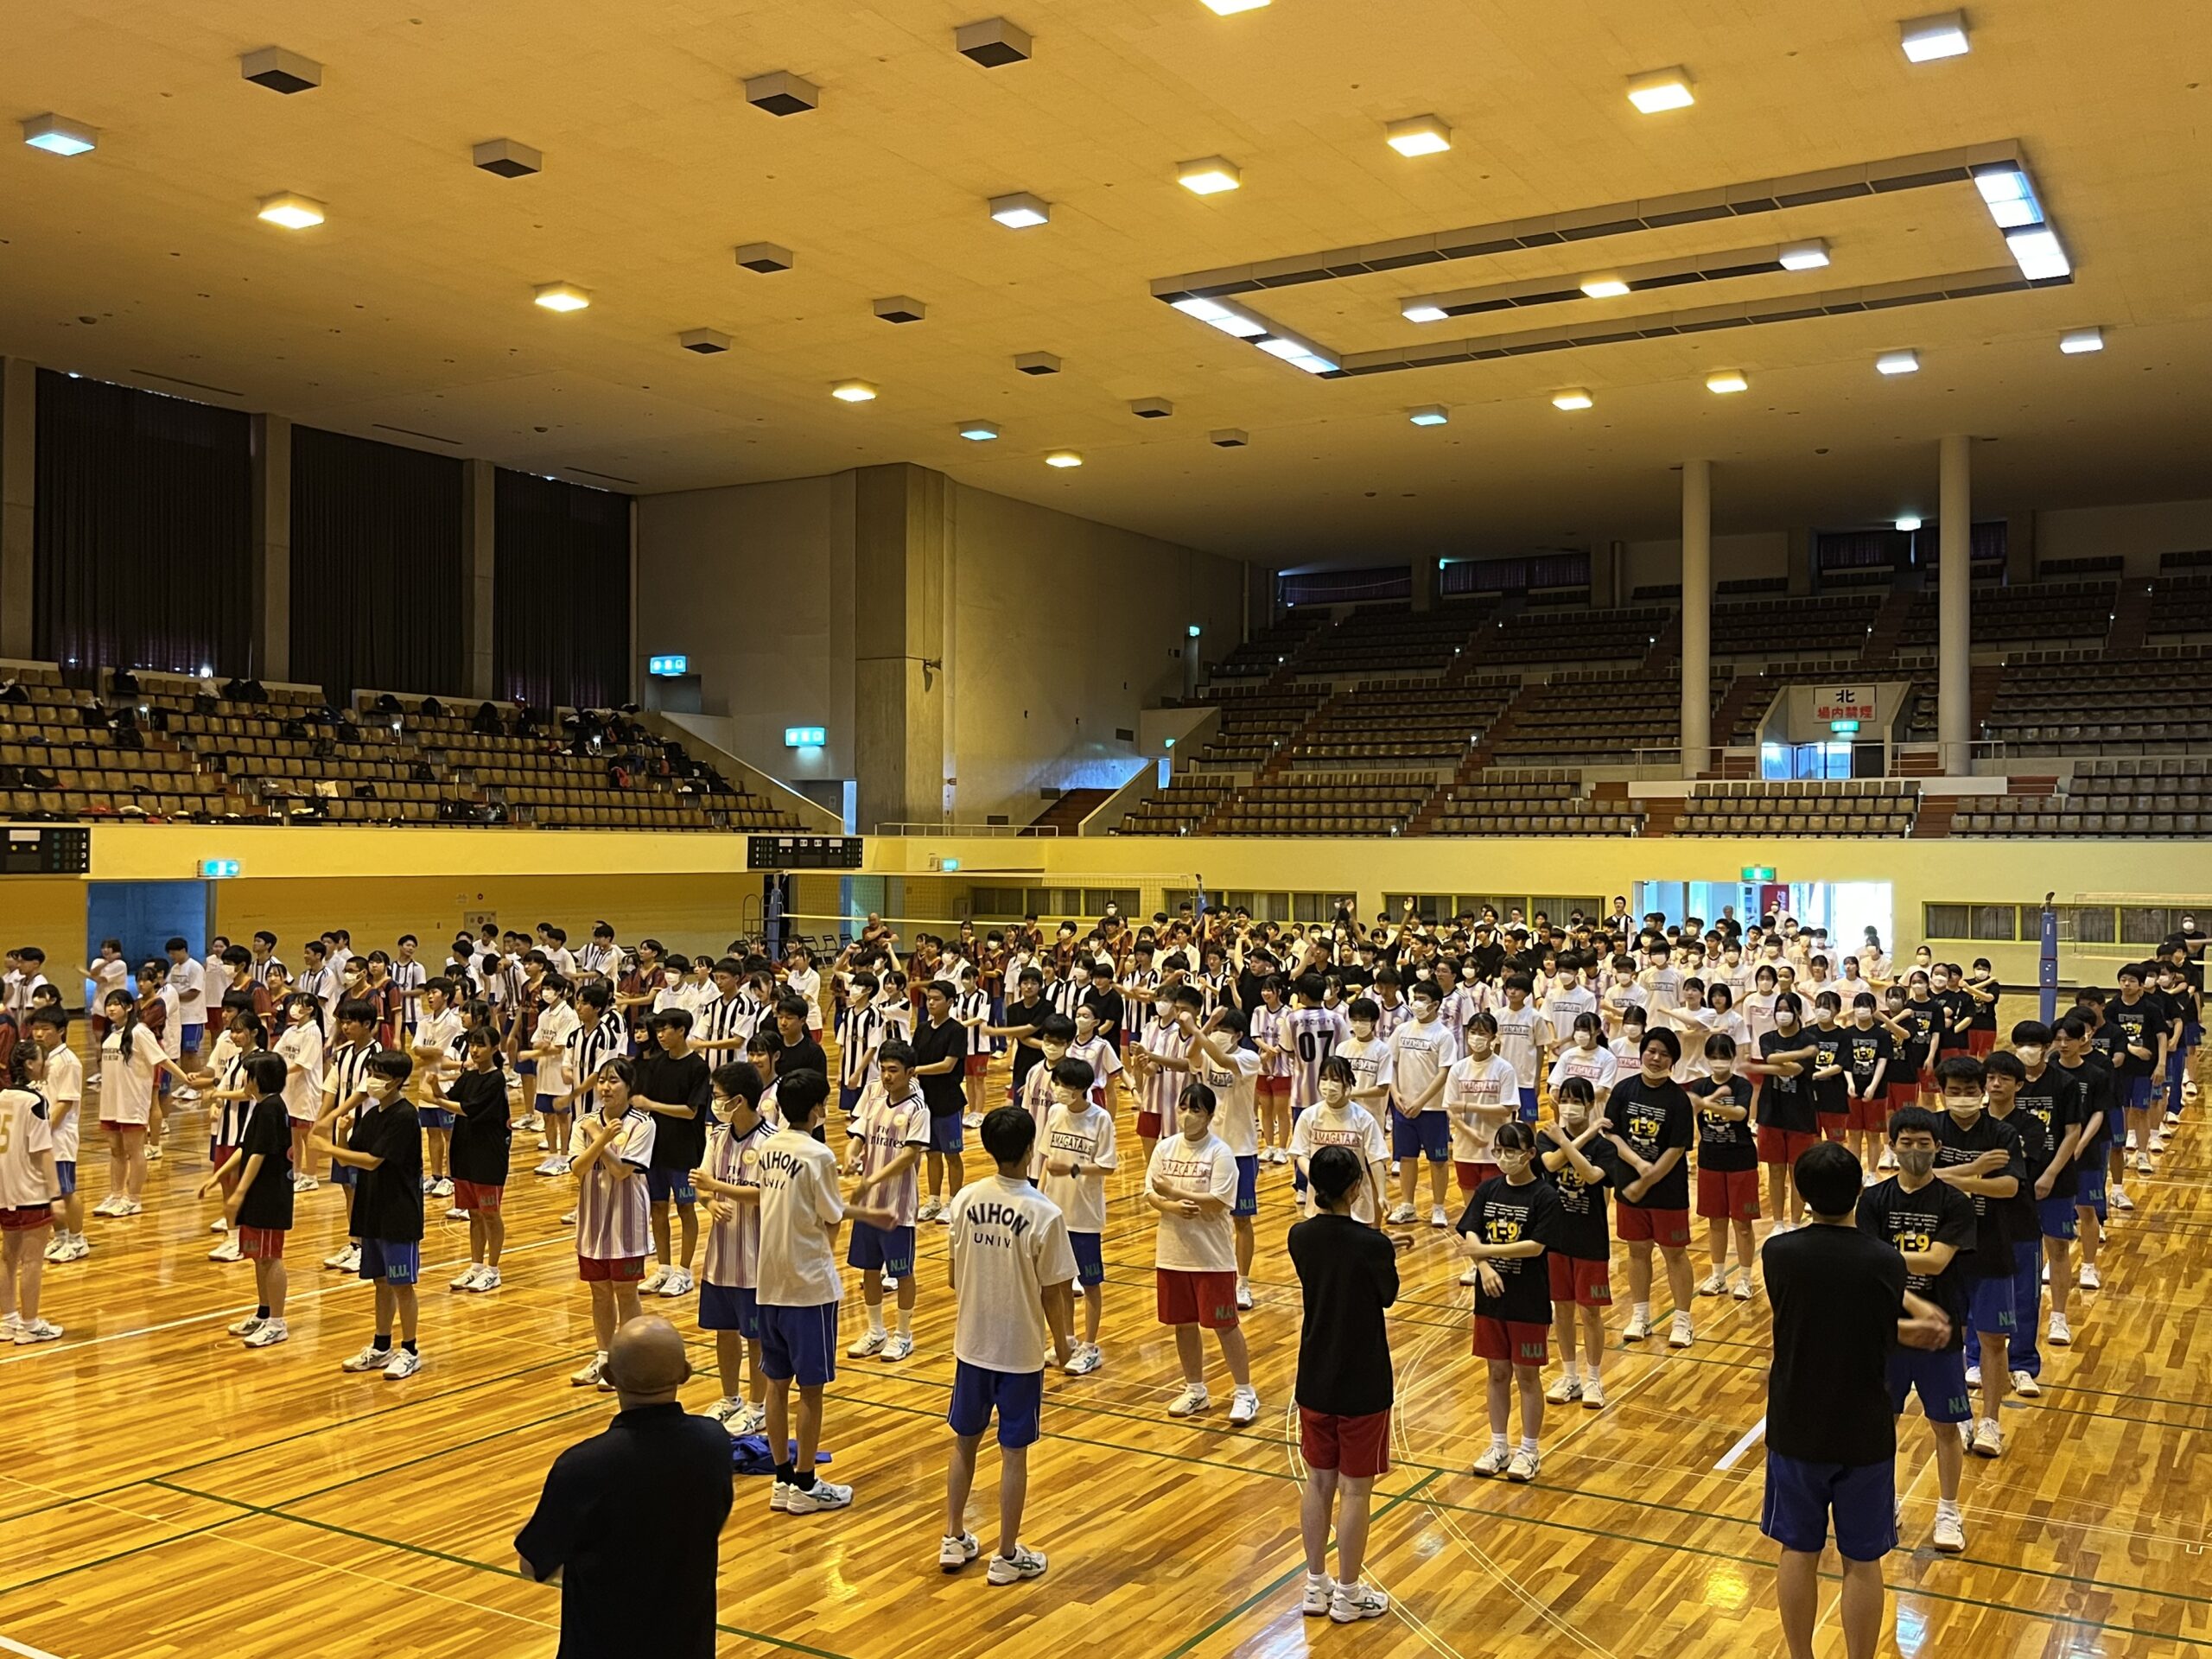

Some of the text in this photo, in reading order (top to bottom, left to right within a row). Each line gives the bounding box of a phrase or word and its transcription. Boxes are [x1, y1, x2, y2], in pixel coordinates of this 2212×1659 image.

[1835, 689, 1855, 703] 北
[1817, 705, 1873, 719] 場内禁煙
[81, 841, 87, 849] 2
[1298, 1030, 1334, 1062] 07
[1630, 1118, 1657, 1134] 1-9
[759, 1151, 804, 1180] NIHON
[967, 1203, 1030, 1237] NIHON
[1487, 1220, 1518, 1241] 1-9
[1895, 1232, 1930, 1253] 1-9
[389, 1265, 410, 1279] N.U.
